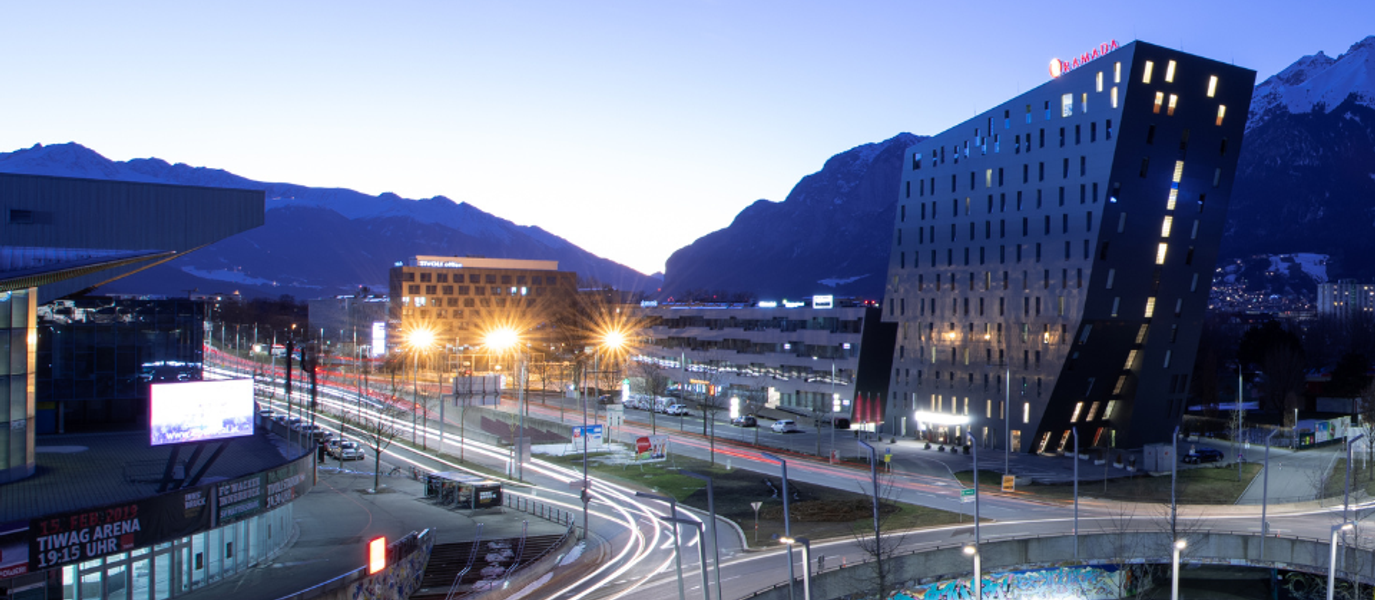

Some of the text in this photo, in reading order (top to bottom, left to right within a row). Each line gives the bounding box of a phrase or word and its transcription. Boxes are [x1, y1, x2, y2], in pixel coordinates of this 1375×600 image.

[1062, 39, 1119, 73] RAMADA
[219, 477, 260, 496] FC WACKER
[219, 487, 260, 506] INNSBRUCK
[37, 518, 140, 552] TIWAG ARENA
[40, 519, 63, 536] 15.
[104, 504, 138, 522] 2019
[38, 538, 117, 568] 19:15 UHR
